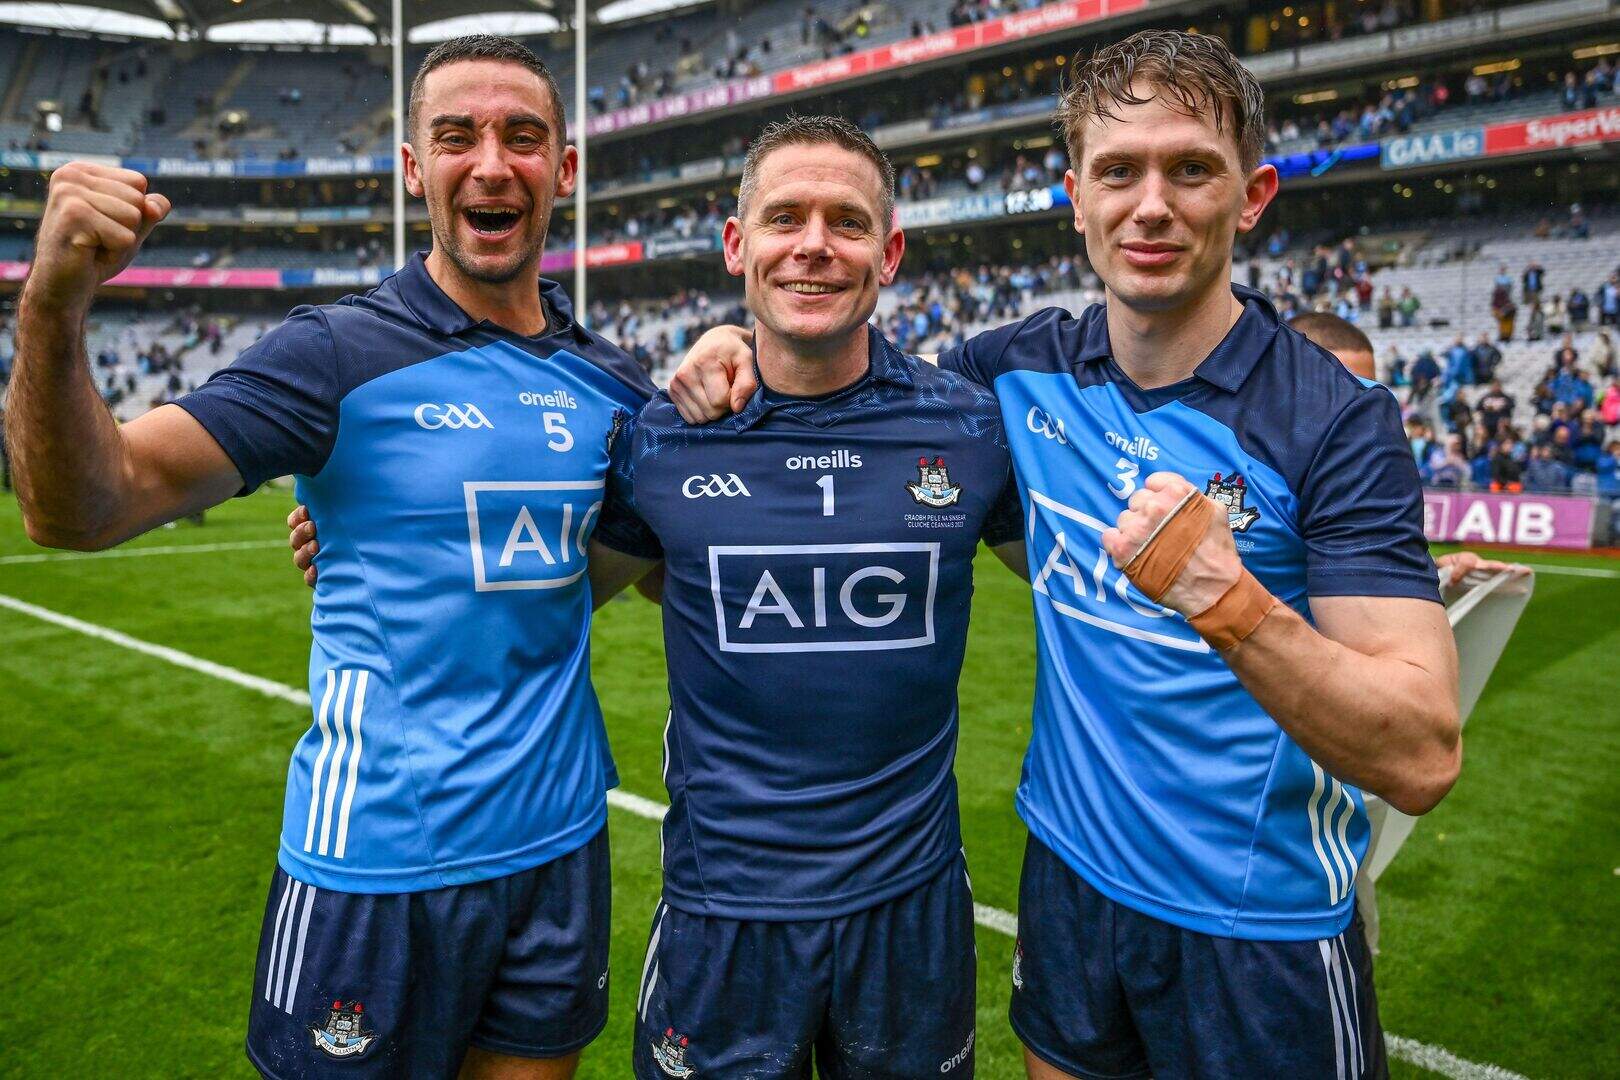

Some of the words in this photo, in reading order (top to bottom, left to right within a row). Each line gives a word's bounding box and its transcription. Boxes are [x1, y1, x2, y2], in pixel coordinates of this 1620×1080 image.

[413, 403, 495, 430] GAA
[543, 412, 574, 452] 5
[681, 473, 751, 499] GAA
[815, 474, 835, 516] 1
[1106, 457, 1140, 500] 3
[1453, 499, 1554, 545] AIB
[738, 566, 908, 629] AIG
